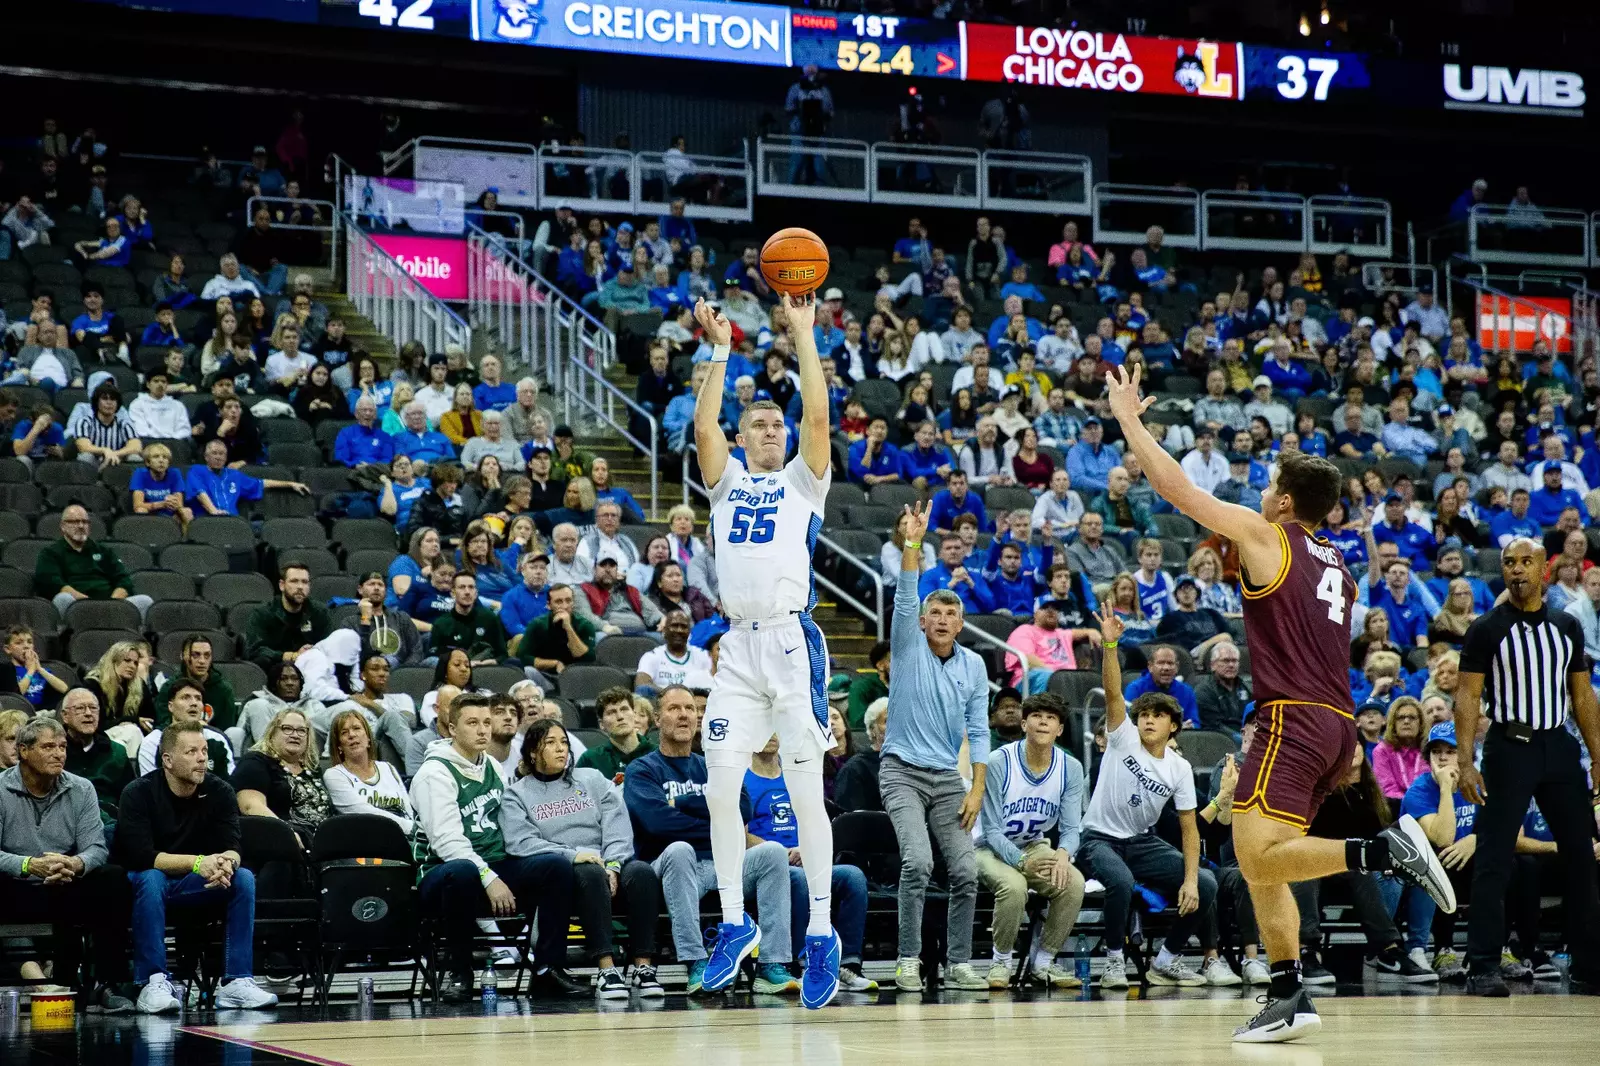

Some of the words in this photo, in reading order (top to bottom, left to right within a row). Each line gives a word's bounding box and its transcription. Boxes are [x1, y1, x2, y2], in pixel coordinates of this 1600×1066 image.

[359, 0, 434, 30] 42
[564, 2, 780, 52] CREIGHTON
[793, 14, 837, 30] BONUS
[852, 14, 899, 38] 1ST
[837, 40, 914, 75] 52.4
[1015, 25, 1132, 62] LOYOLA
[1003, 54, 1144, 92] CHICAGO
[1276, 55, 1339, 100] 37
[1443, 63, 1587, 107] UMB
[728, 486, 785, 507] CEIGTON
[728, 505, 778, 544] 55
[1316, 566, 1346, 626] 4
[1002, 797, 1058, 819] CREIGHTON
[1004, 819, 1048, 840] 25
